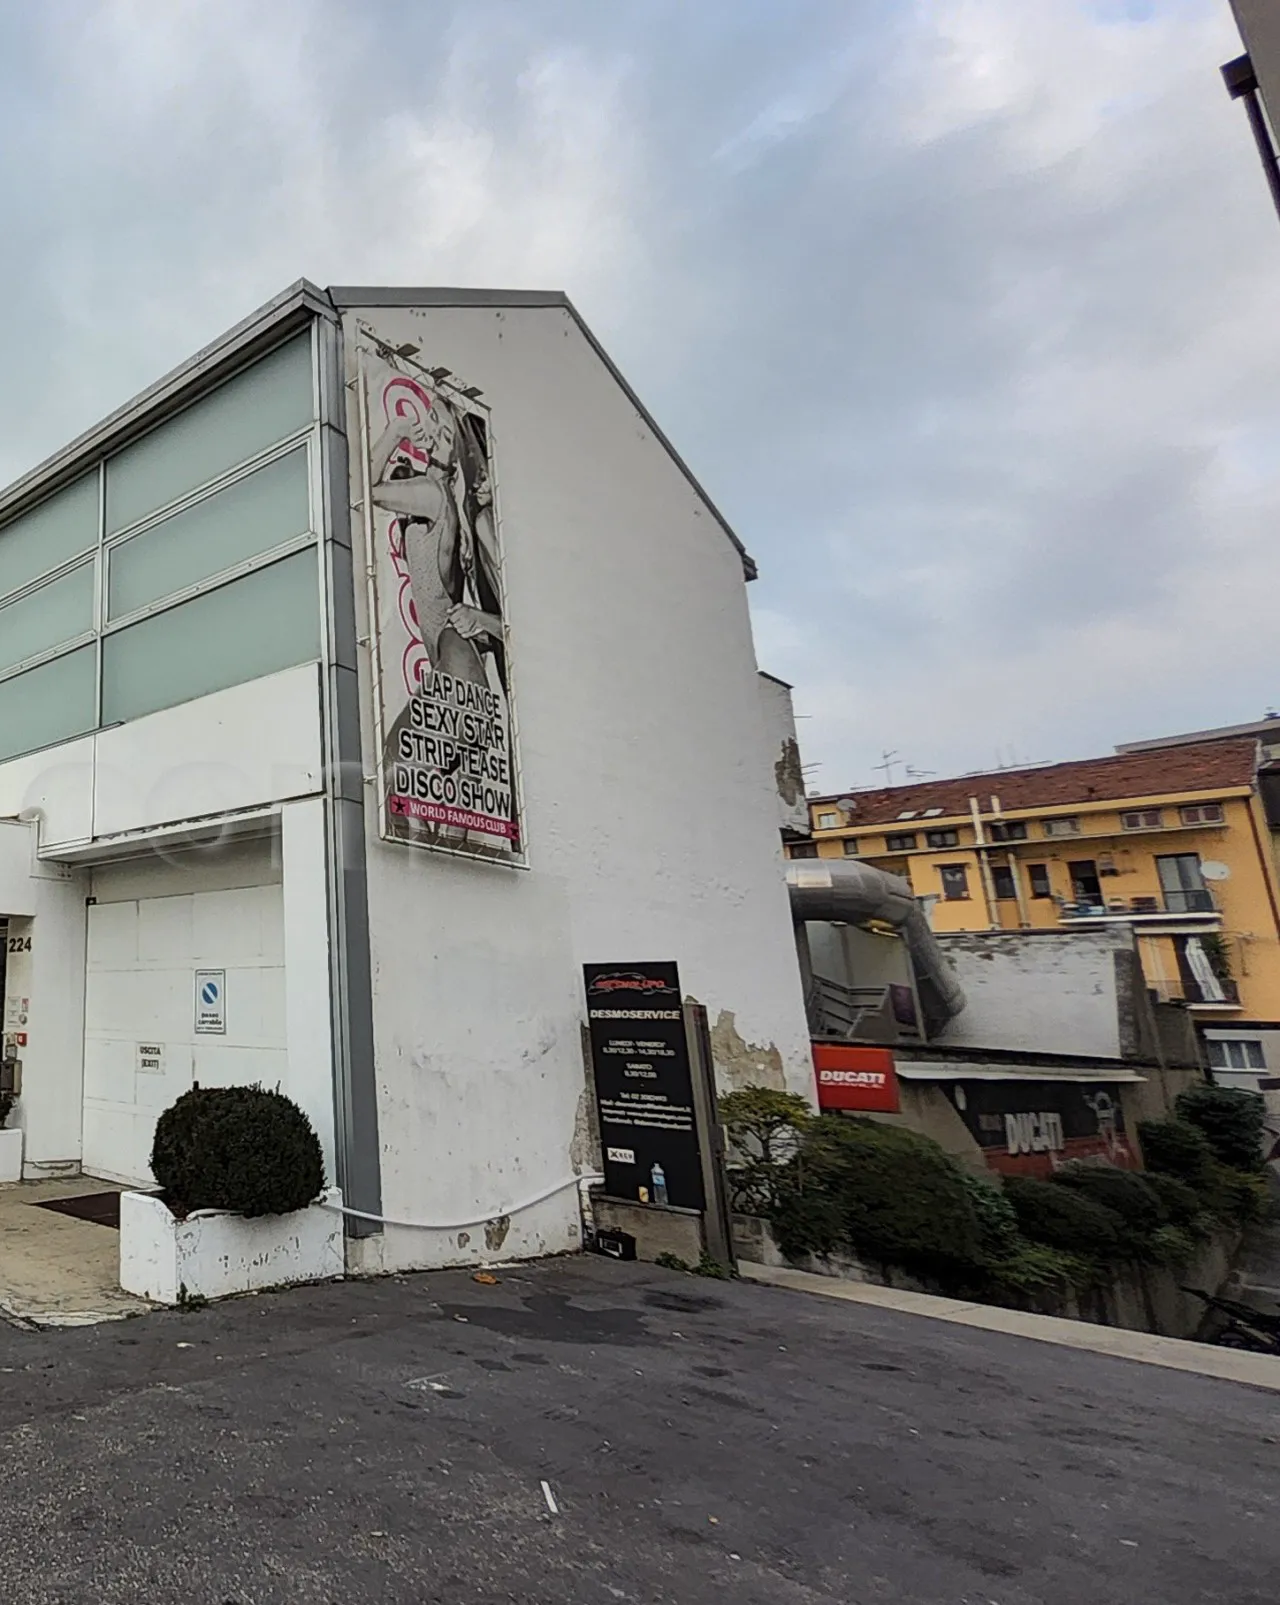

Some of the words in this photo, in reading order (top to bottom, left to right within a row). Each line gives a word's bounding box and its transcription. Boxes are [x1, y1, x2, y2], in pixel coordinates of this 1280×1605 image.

[422, 669, 453, 701] LAP
[456, 679, 502, 720] DANCE
[410, 699, 460, 737] SEXY
[464, 714, 505, 752] STAR
[400, 730, 454, 768] STRIP
[457, 746, 508, 785] TEASE
[395, 767, 457, 803] DISCO
[461, 780, 510, 818] SHOW
[409, 802, 446, 820] WORLD
[447, 809, 486, 829] FAMOUS
[486, 817, 507, 834] CLUB
[9, 936, 32, 953] 224
[590, 1009, 681, 1021] DESMOSERVICE
[139, 1046, 161, 1056] USCITA
[819, 1069, 886, 1084] DUCATI
[1003, 1110, 1065, 1155] DUCATI
